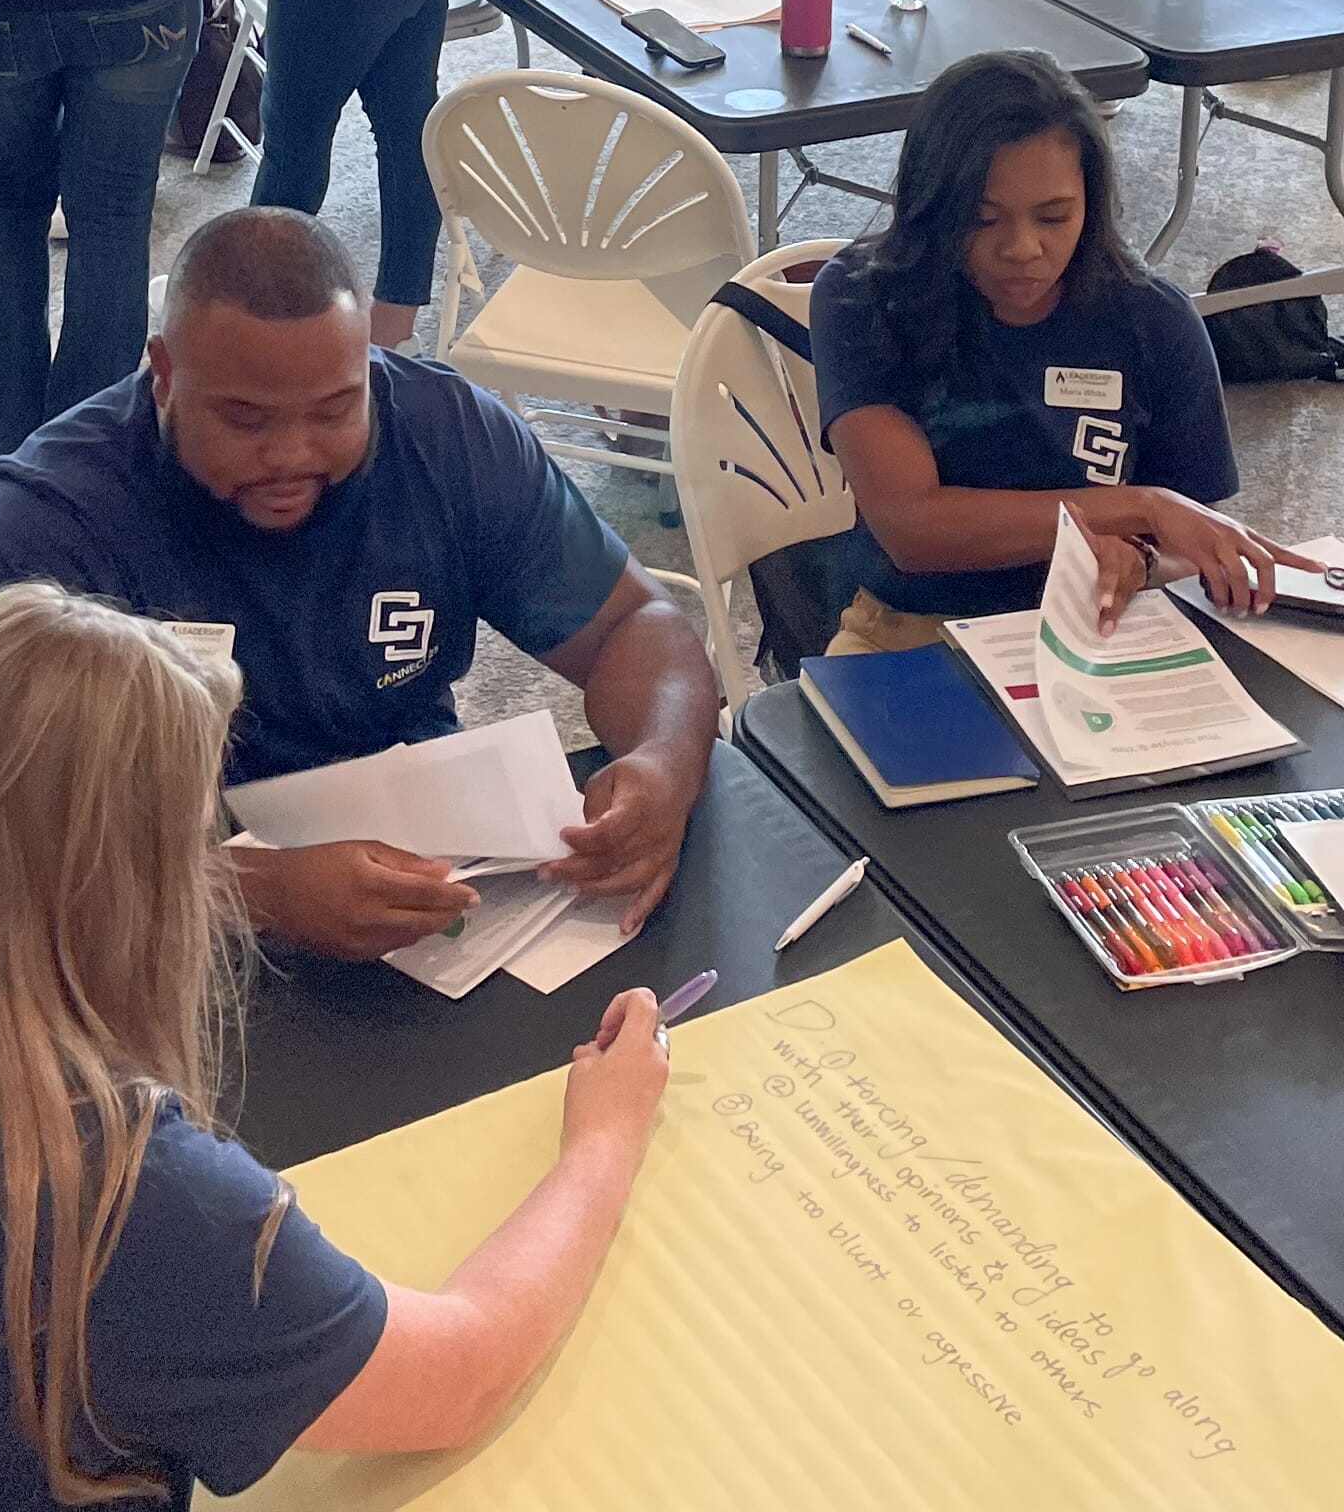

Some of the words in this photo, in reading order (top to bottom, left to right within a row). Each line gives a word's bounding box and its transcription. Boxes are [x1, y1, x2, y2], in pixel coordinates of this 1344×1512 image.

[178, 626, 226, 636] LEADERSHIP
[730, 1121, 785, 1183] Being
[798, 1190, 824, 1219] too
[828, 1221, 891, 1281] blunt
[897, 1298, 923, 1318] or
[773, 1039, 823, 1088] with
[896, 1166, 981, 1246] opinions
[1037, 1311, 1106, 1366] ideas
[903, 1213, 921, 1233] to
[929, 1241, 986, 1303] listen
[995, 1311, 1018, 1332] to
[1031, 1349, 1102, 1419] others
[1084, 1311, 1113, 1336] to
[1102, 1352, 1156, 1378] go
[1163, 1389, 1236, 1460] along
